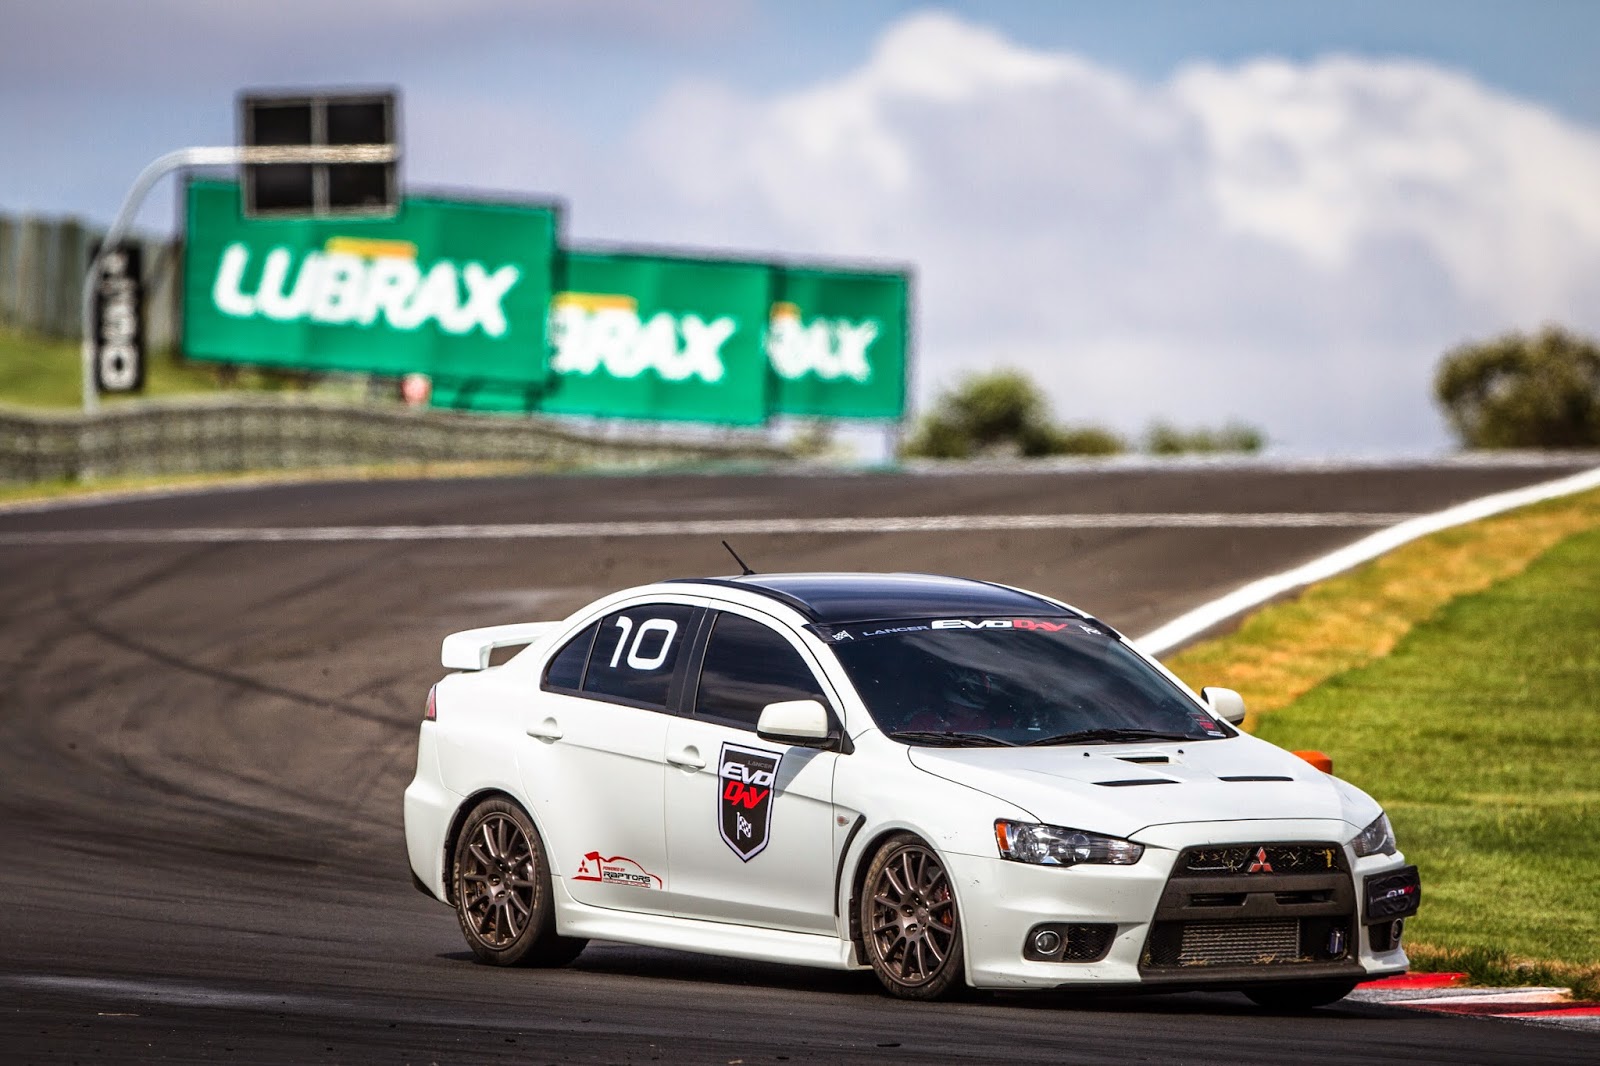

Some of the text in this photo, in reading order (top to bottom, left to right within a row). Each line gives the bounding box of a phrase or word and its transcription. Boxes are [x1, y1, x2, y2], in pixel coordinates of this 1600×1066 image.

[213, 242, 520, 340] LUBRAX
[609, 615, 678, 671] 10
[862, 625, 930, 636] LANCER
[722, 761, 773, 786] EVO
[747, 760, 773, 769] LANCER
[724, 780, 769, 809] DAY
[603, 871, 651, 883] RAPTORS
